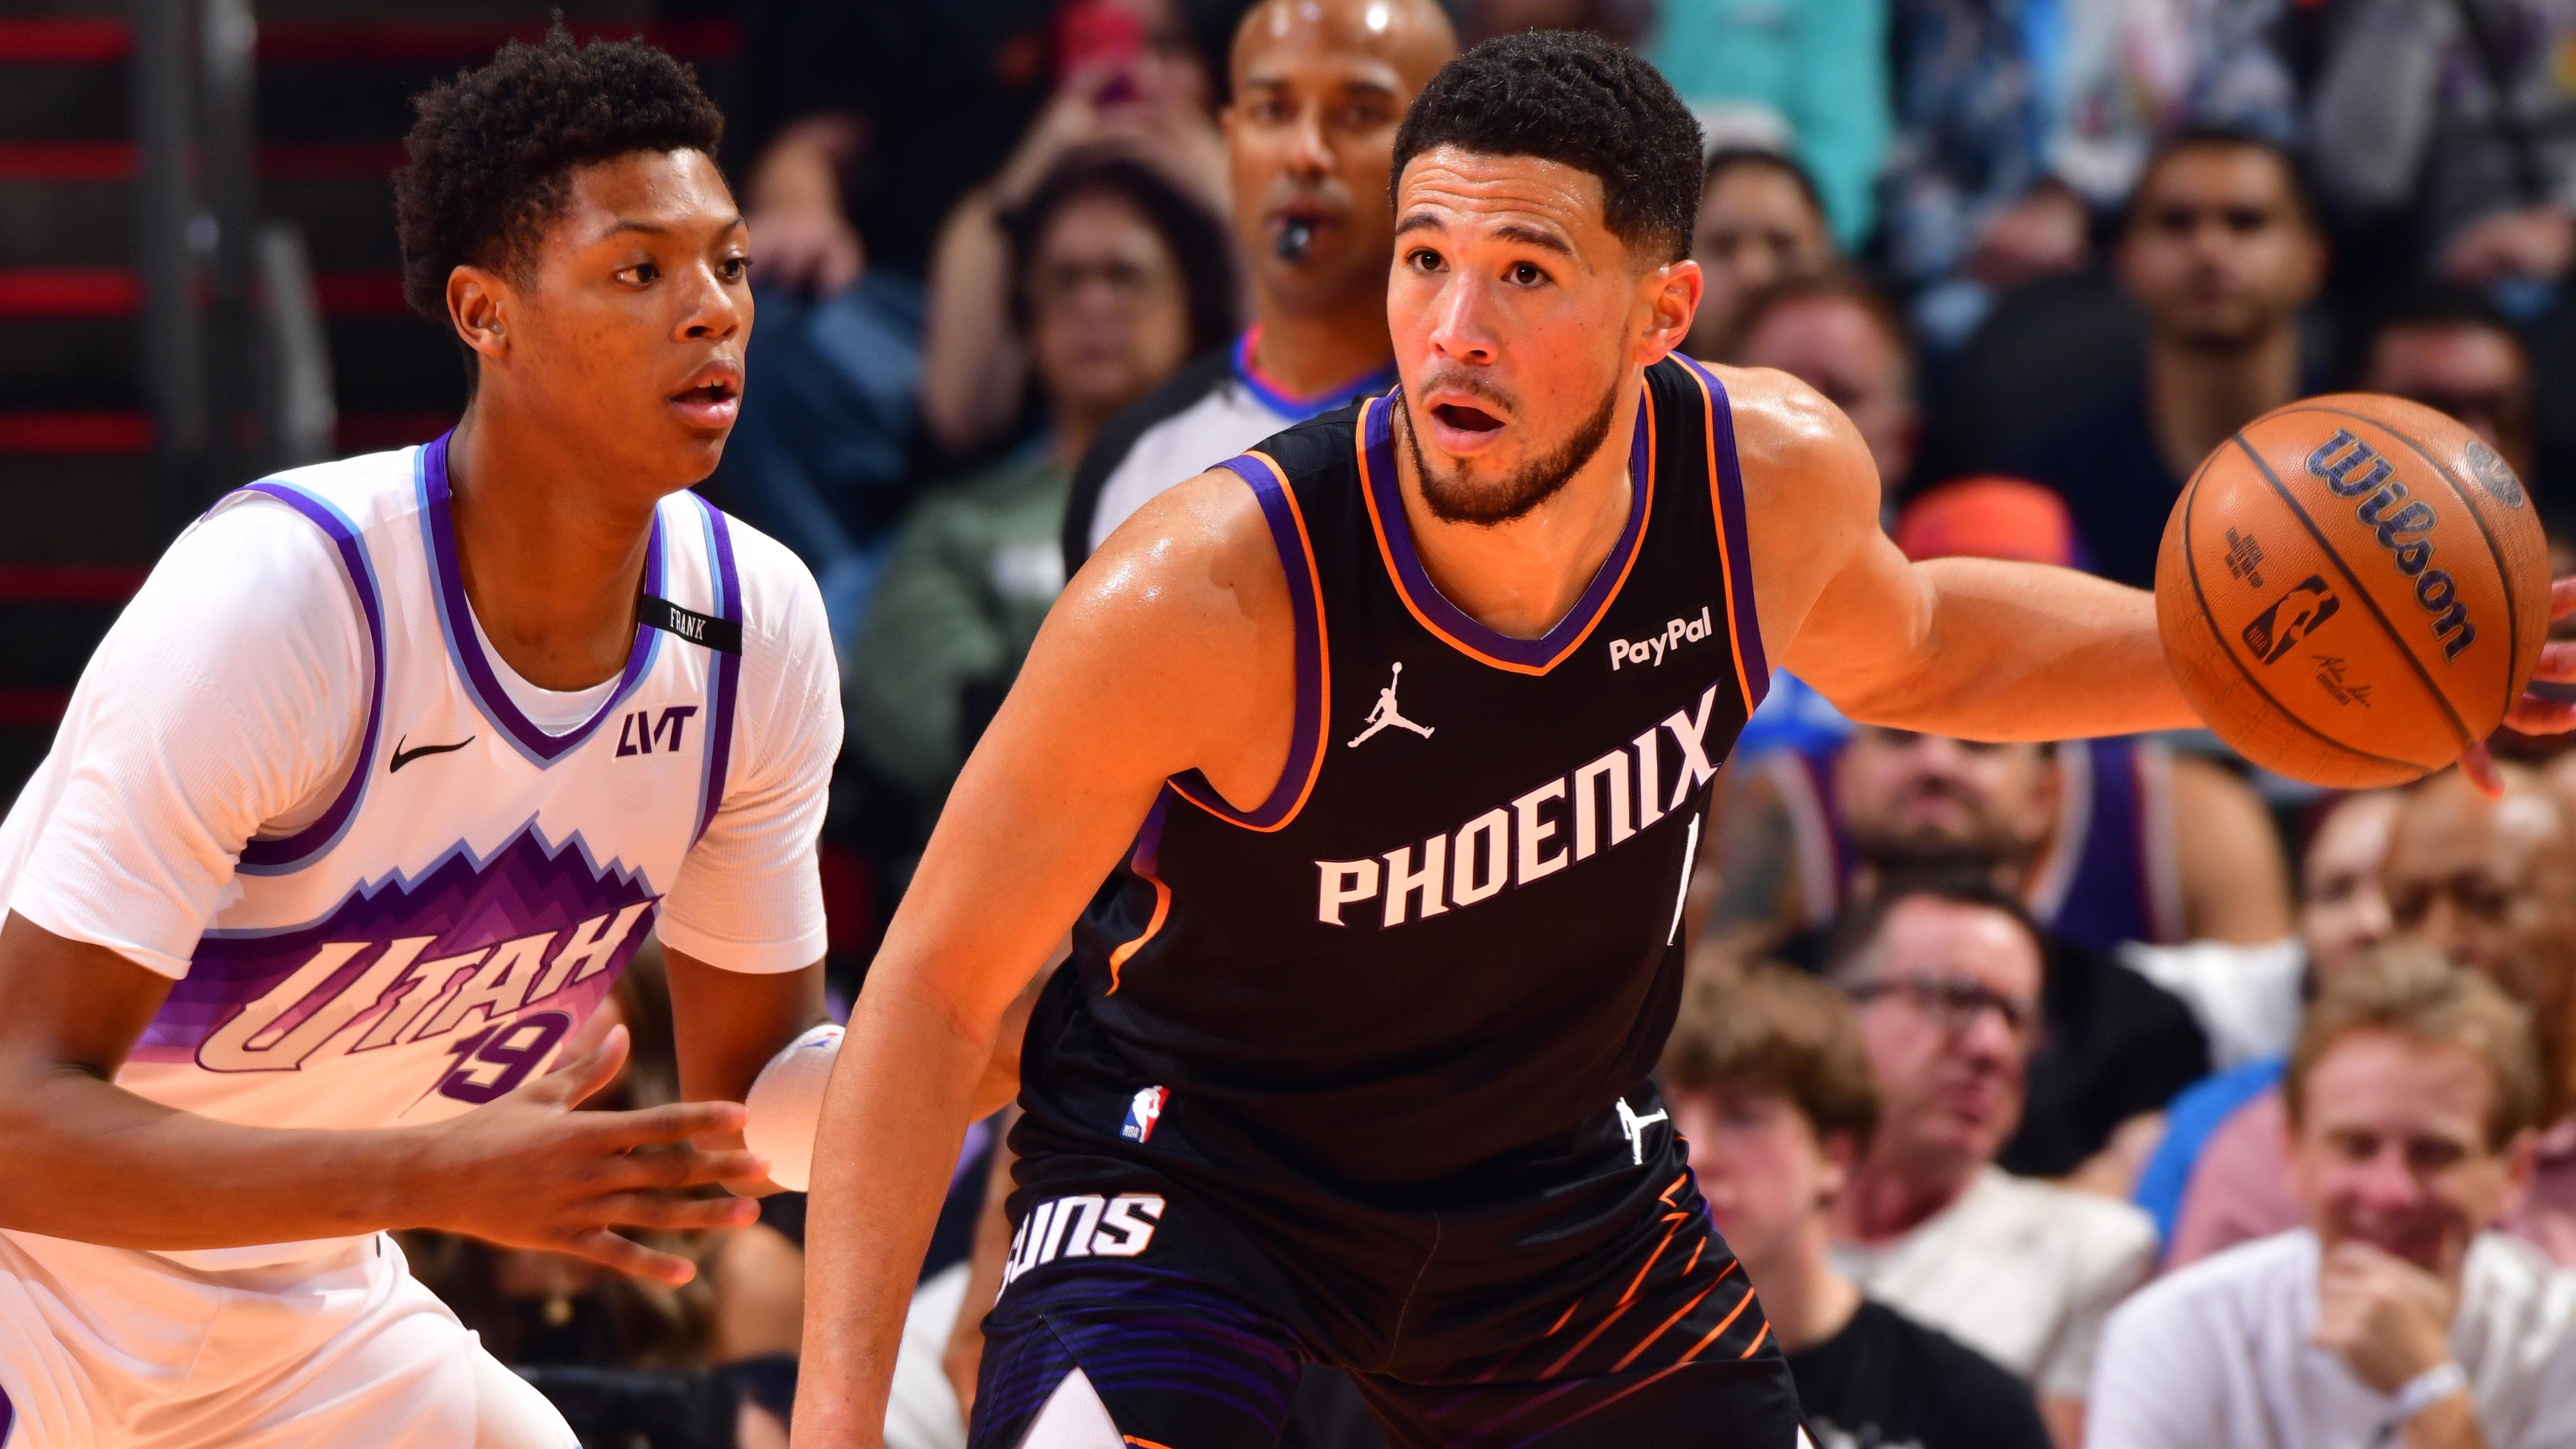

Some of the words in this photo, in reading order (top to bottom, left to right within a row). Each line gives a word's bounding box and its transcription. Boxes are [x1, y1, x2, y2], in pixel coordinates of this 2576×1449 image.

[2305, 428, 2478, 667] Wilson
[670, 606, 707, 640] FRANK
[1609, 606, 1713, 671] PayPal
[1313, 680, 1722, 929] PHOENIX
[194, 893, 665, 1073] UTAH
[430, 1009, 573, 1107] 19
[1122, 1124, 1139, 1138] NBA
